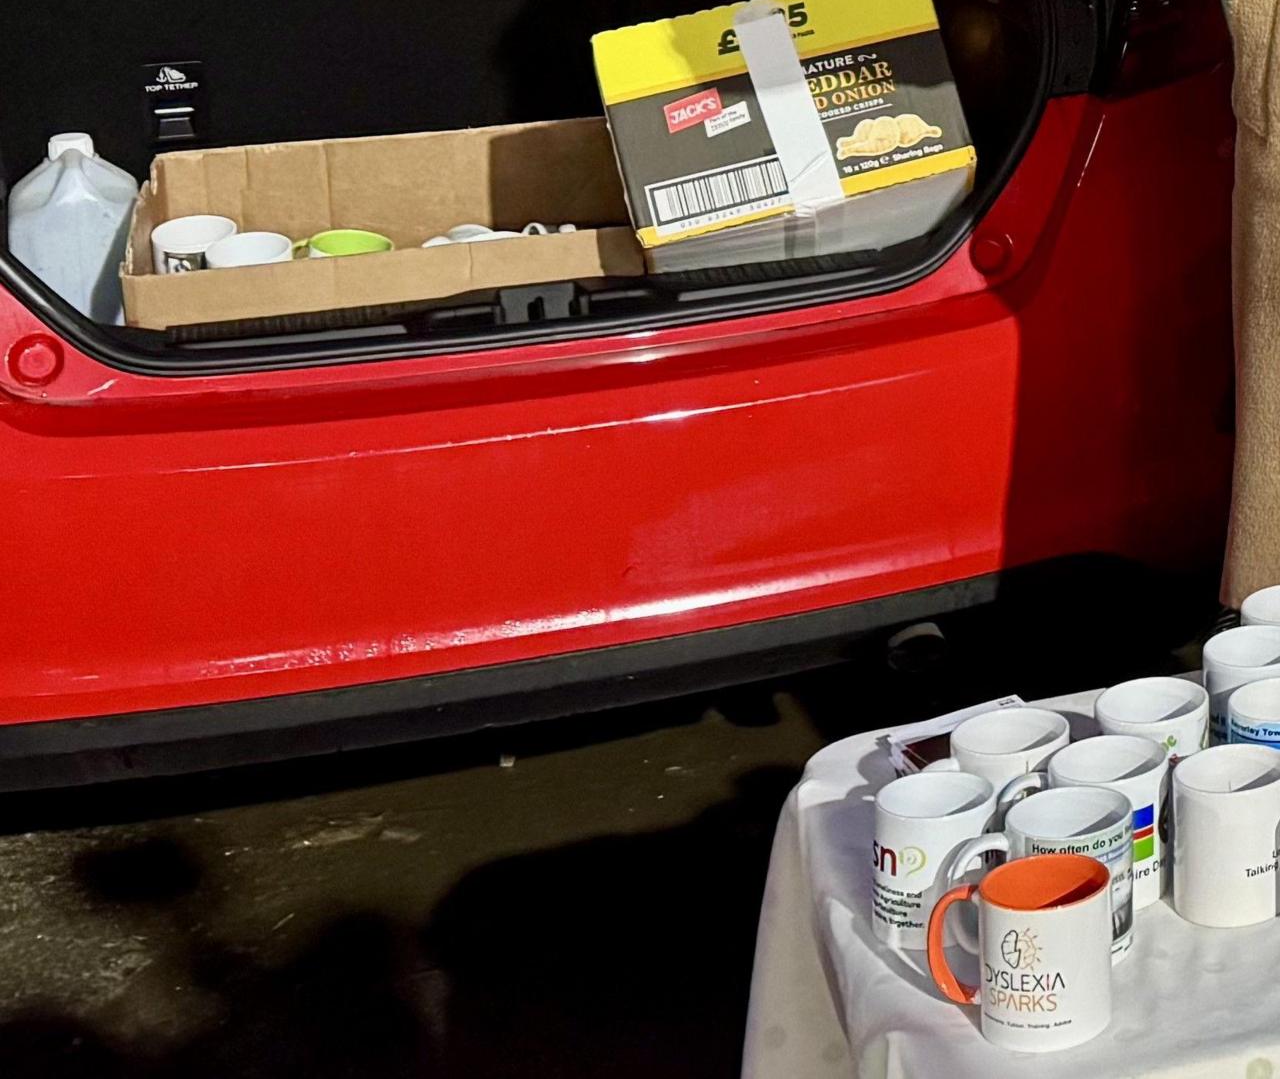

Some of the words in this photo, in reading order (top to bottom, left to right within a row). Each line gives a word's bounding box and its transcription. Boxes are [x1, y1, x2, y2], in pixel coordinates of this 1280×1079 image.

[145, 85, 163, 93] TOP
[164, 81, 199, 91] TETHER
[831, 80, 896, 105] ONION
[1032, 843, 1057, 855] How
[1059, 843, 1090, 855] often
[1092, 838, 1106, 851] do
[1108, 835, 1123, 847] you
[1245, 860, 1279, 878] Talking
[985, 963, 1066, 992] DYSLEXIA
[990, 987, 1058, 1012] SPARKS
